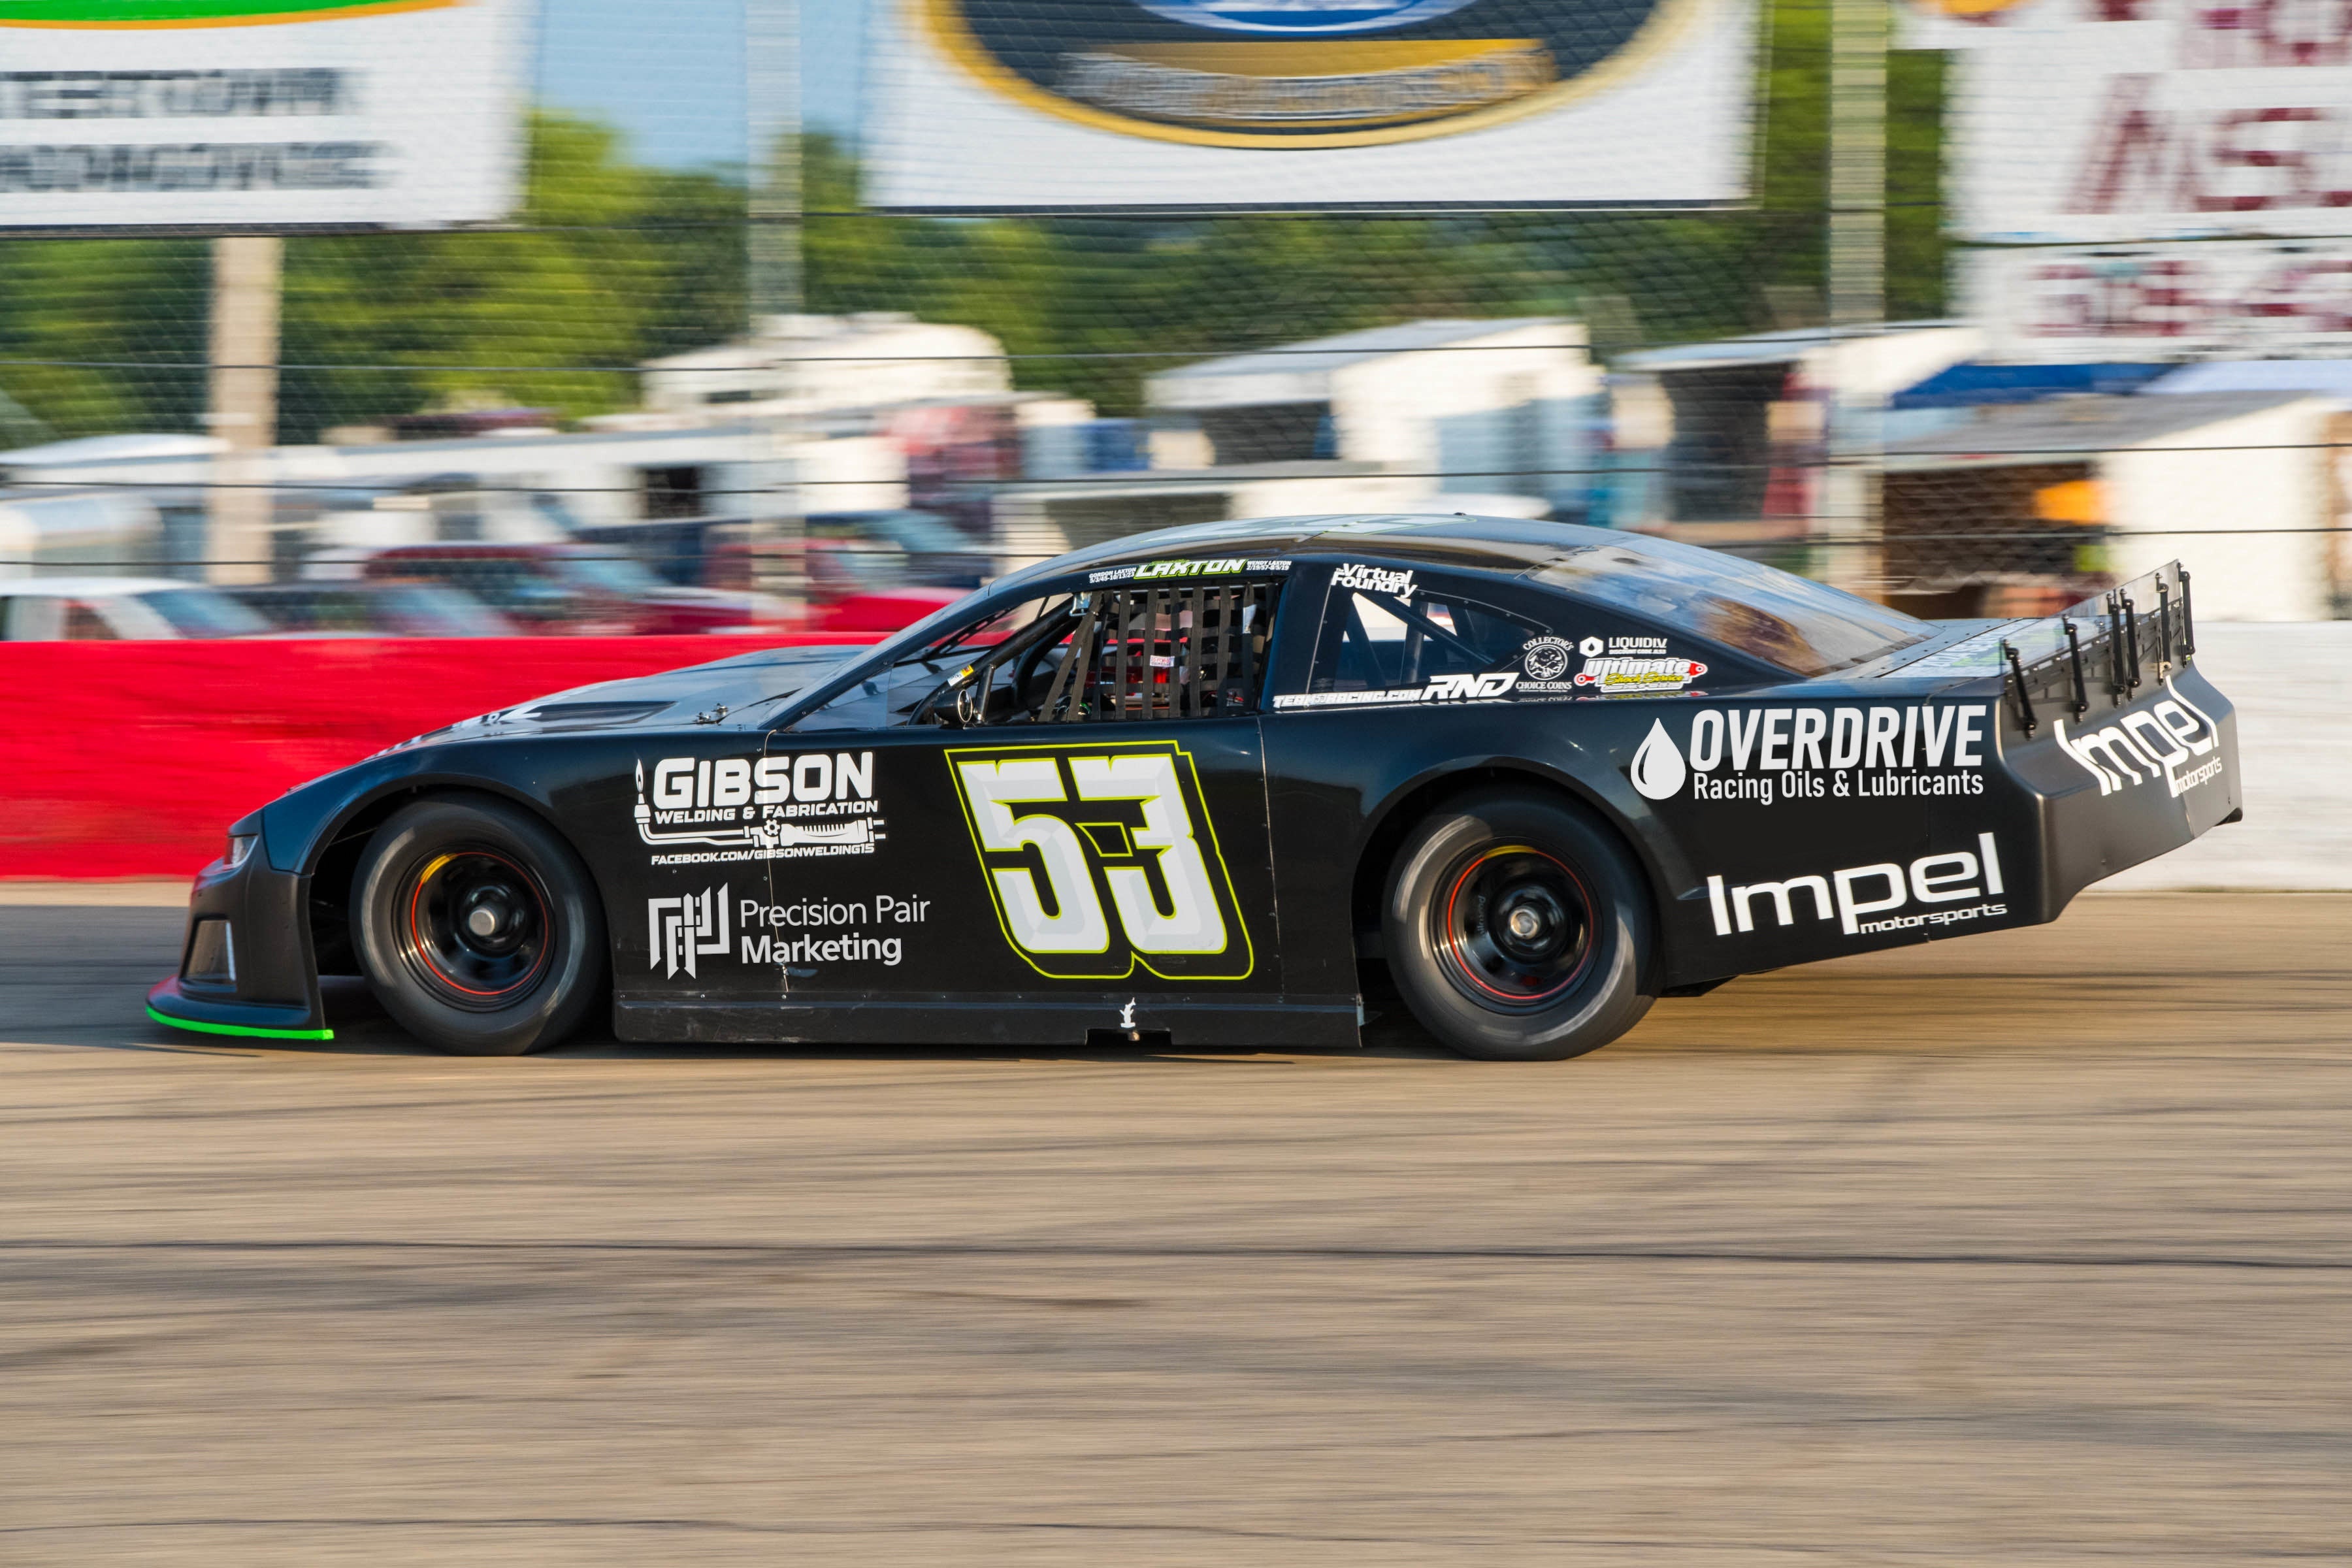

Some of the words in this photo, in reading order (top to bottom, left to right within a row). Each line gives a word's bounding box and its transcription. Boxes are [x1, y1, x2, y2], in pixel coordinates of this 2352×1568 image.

[1089, 570, 1113, 579] GORDON
[1114, 567, 1136, 576] LAXTON
[1134, 559, 1249, 580] LAXTON
[1330, 571, 1418, 598] Foundry
[1343, 563, 1414, 583] Virtual
[1523, 636, 1574, 651] COLLECTOR'S
[1421, 672, 1520, 700] RND
[1643, 672, 1684, 683] Service
[1690, 705, 1987, 772] OVERDRIVE
[2053, 675, 2219, 798] Impel
[653, 751, 874, 809] GIBSON
[1694, 772, 1773, 806] Racing
[1782, 770, 1825, 798] Oils
[1833, 770, 1850, 797] &
[1858, 768, 1984, 796] Lubricants
[2176, 756, 2222, 793] motorsports
[655, 808, 735, 825] WELDING
[743, 806, 756, 819] &
[762, 800, 878, 819] FABRICATION
[651, 842, 875, 865] FACEBOOK.COM/GIBSONWELDING15
[956, 753, 1228, 954] 53
[1707, 832, 2004, 936] Impel
[740, 897, 867, 928] Precision
[876, 894, 931, 923] Pair
[1859, 904, 2008, 934] motorsports
[742, 932, 902, 966] Marketing
